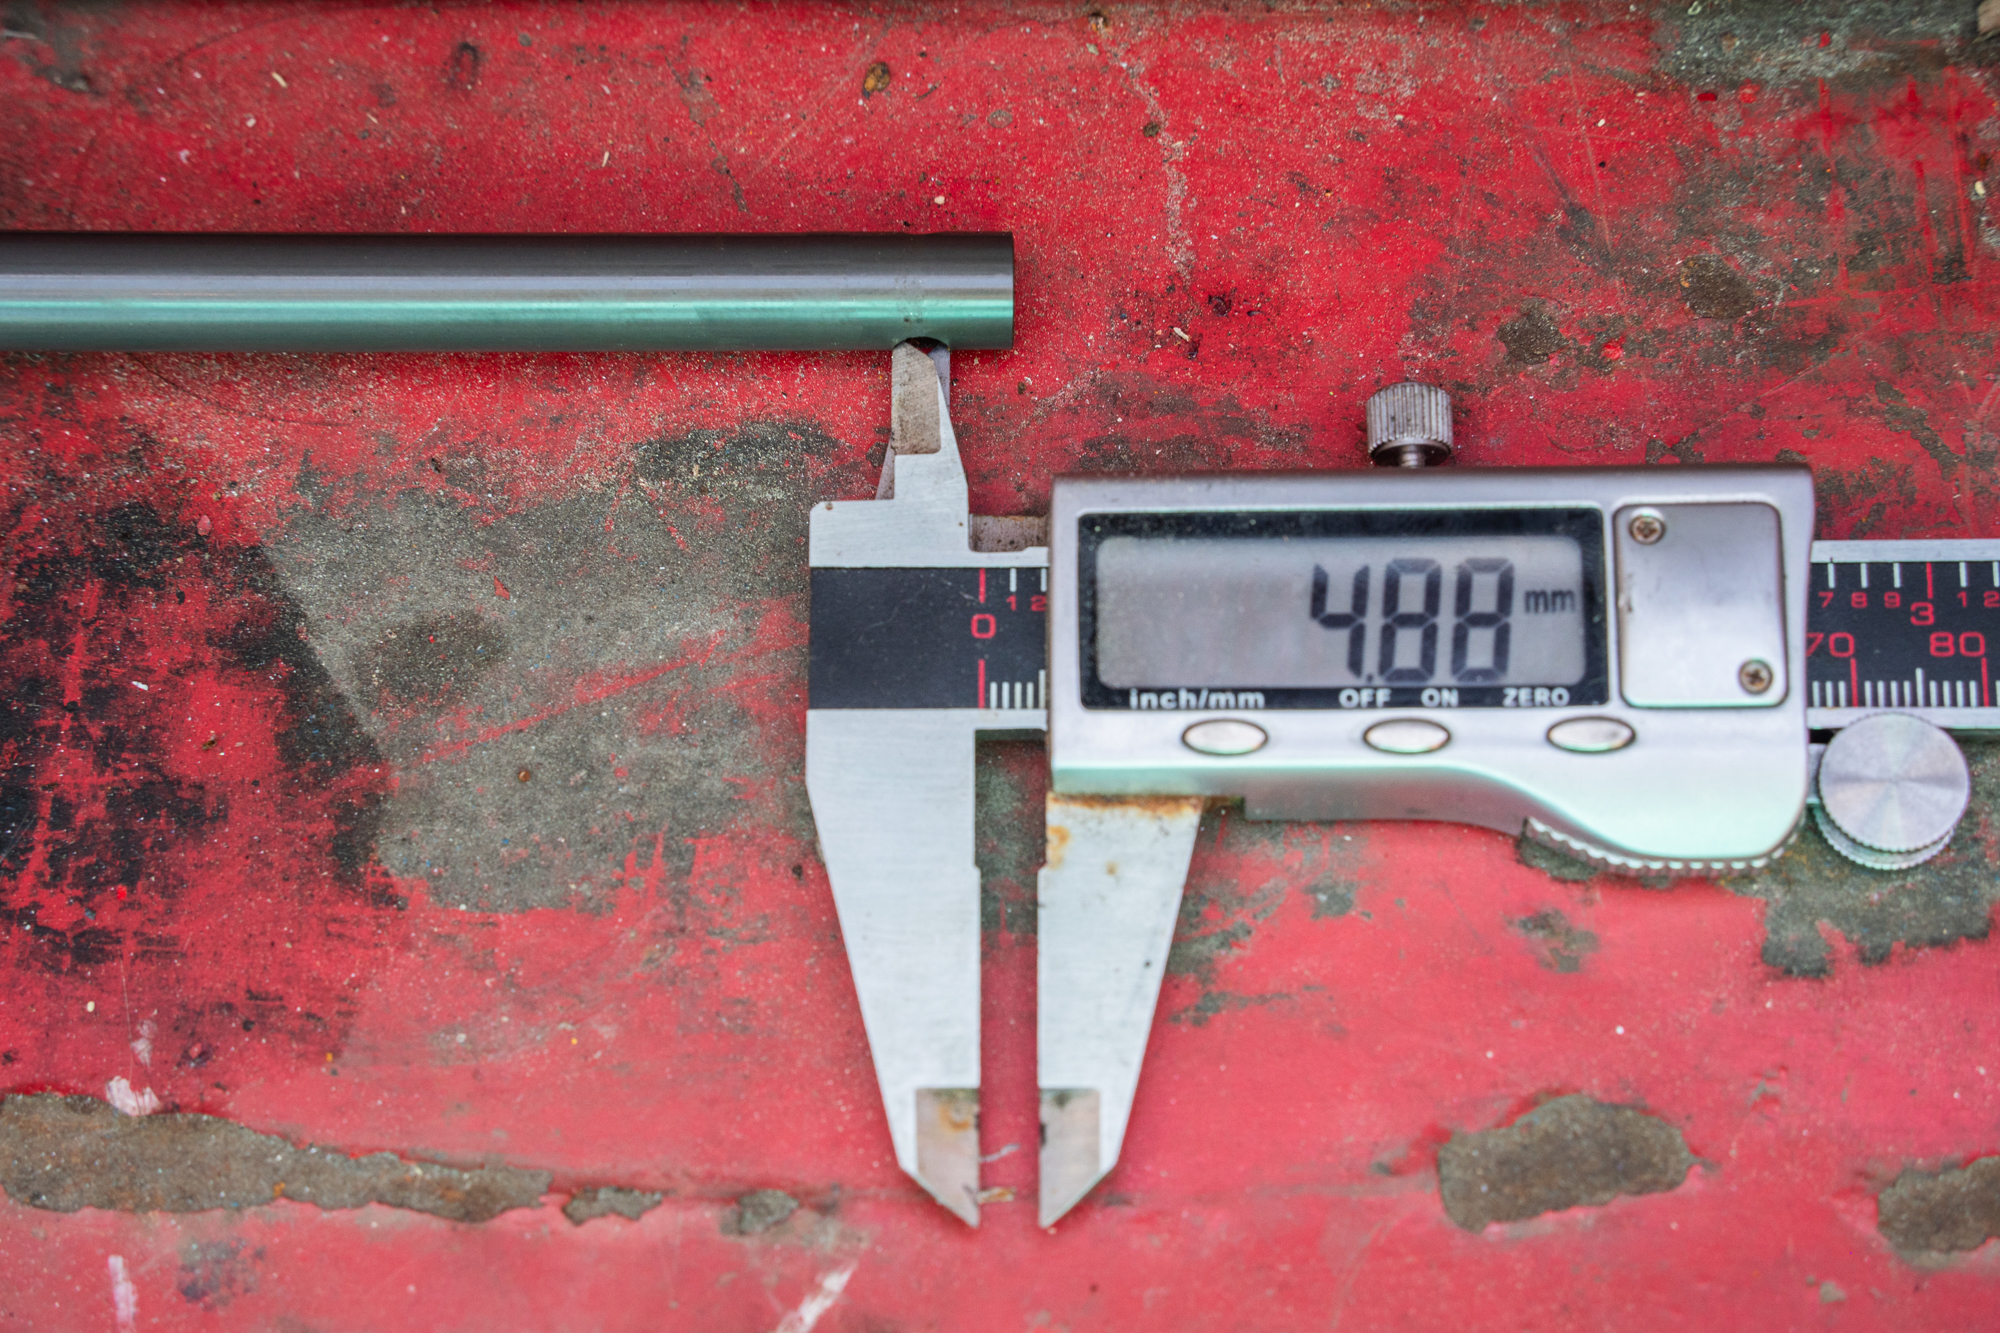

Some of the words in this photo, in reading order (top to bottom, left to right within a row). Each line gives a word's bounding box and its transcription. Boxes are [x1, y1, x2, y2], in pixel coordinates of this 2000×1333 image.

[1006, 595, 1017, 611] 1
[1030, 595, 1047, 611] 2
[1524, 589, 1575, 614] mm
[1818, 591, 1834, 608] 7
[1851, 591, 1867, 608] 8
[1910, 602, 1935, 625] 3
[1957, 591, 1967, 607] 1
[1983, 590, 2000, 607] 2
[970, 613, 996, 639] 0
[1805, 632, 1855, 658] 70
[1929, 631, 1986, 658] 80
[1129, 687, 1266, 709] inch/mm
[1338, 687, 1391, 708] OFF
[1420, 687, 1459, 708] ON
[1502, 687, 1570, 707] ZERO
